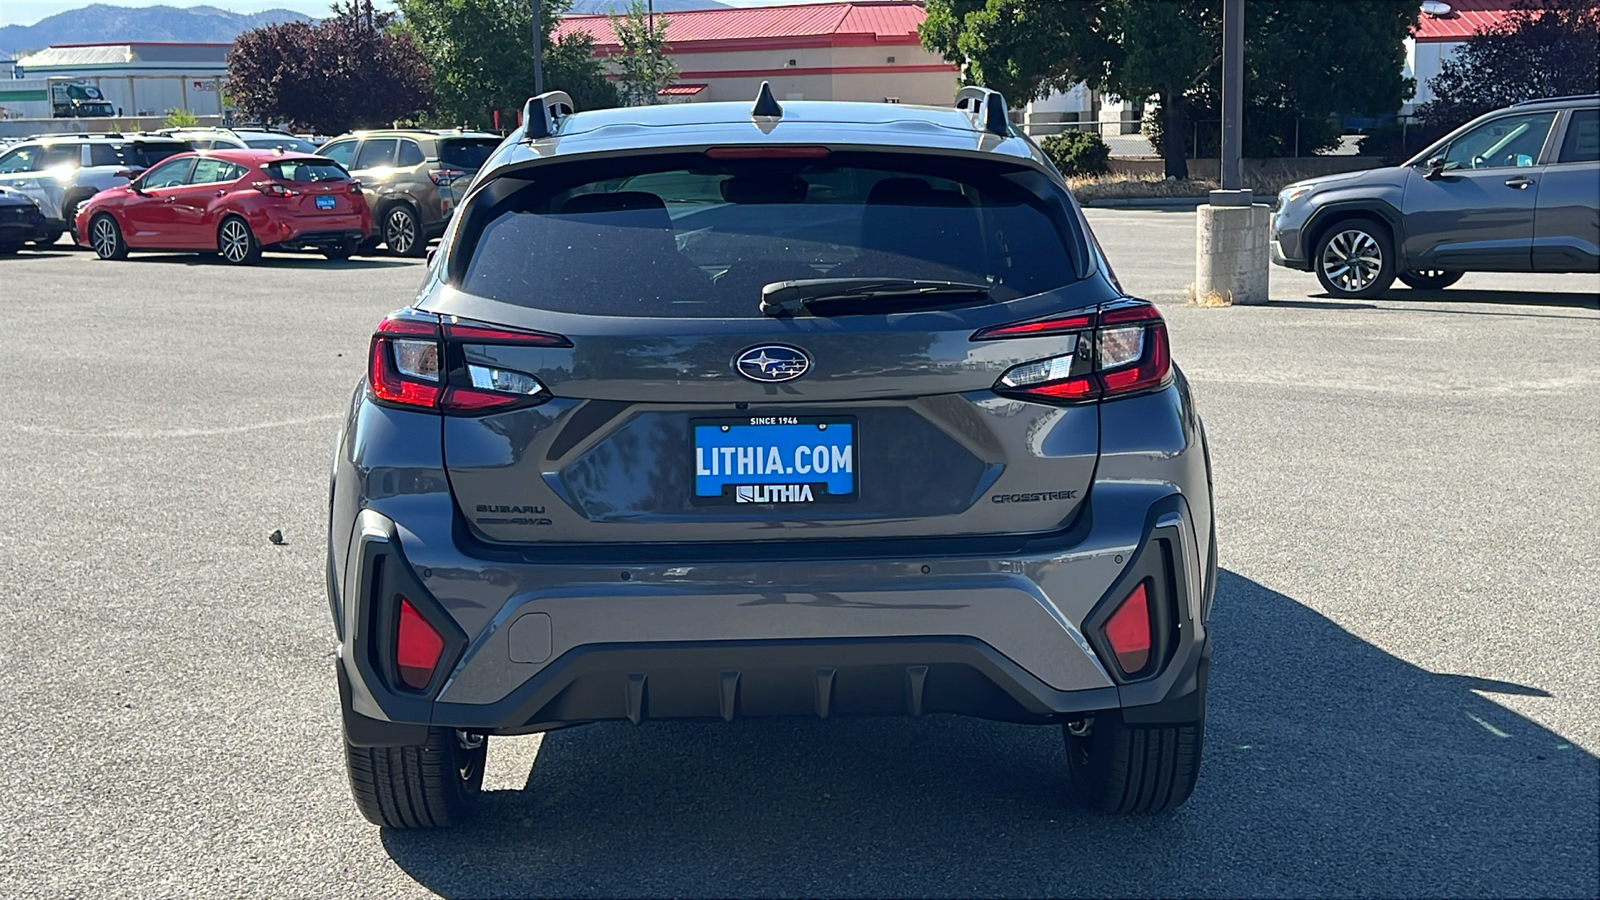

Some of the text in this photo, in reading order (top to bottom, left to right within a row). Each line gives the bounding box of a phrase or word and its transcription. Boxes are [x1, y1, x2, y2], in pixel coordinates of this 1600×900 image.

[750, 417, 798, 425] SINCE 1946
[696, 445, 852, 476] LITHIA.COM
[753, 484, 814, 503] LITHIA
[991, 490, 1078, 504] CROSSTREK
[476, 504, 546, 514] SUBARU
[507, 517, 553, 526] AWD
